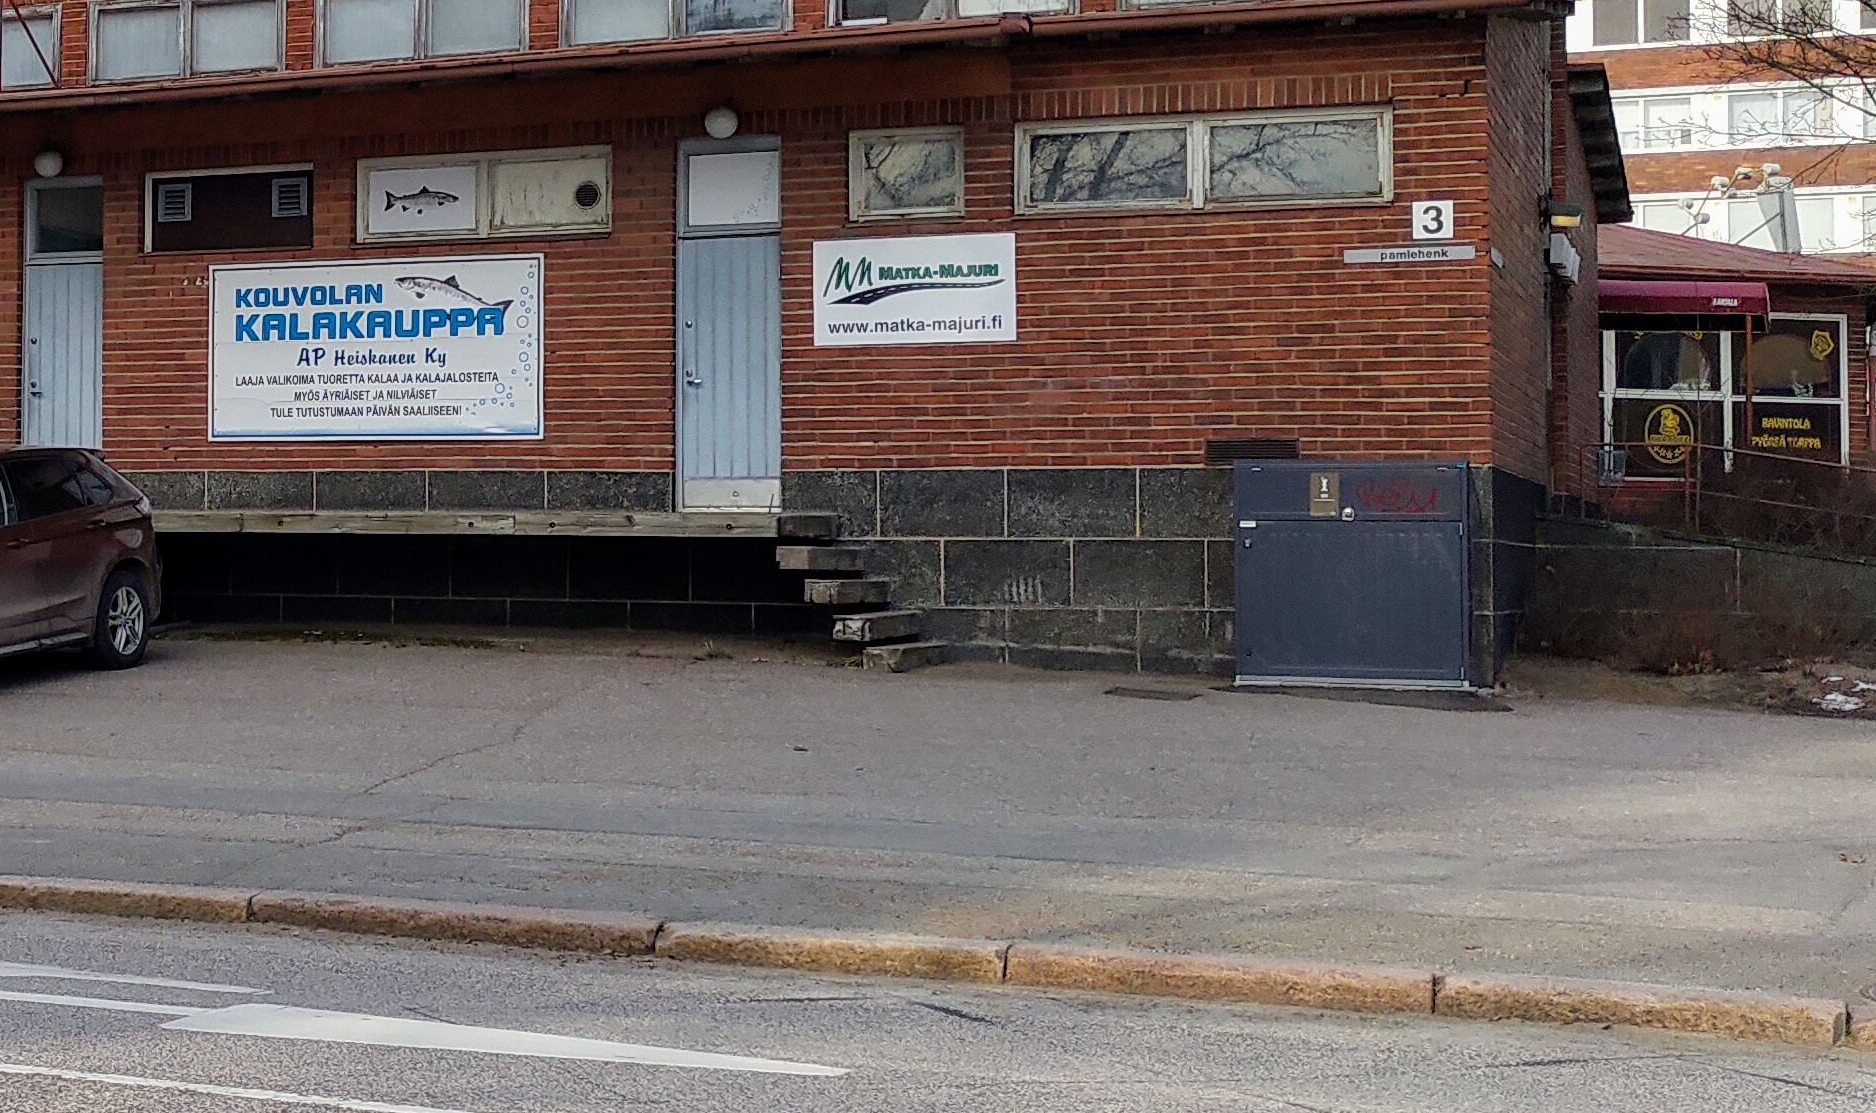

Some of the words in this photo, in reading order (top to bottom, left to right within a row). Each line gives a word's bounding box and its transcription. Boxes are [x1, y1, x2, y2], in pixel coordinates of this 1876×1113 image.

[1421, 205, 1444, 235] 3
[234, 283, 383, 308] KOUVOLAN
[234, 307, 505, 342] KALAKAUPPA
[828, 314, 1002, 334] www.matka-majuri.fi
[297, 347, 326, 367] AP
[333, 348, 417, 367] Heiskanen
[424, 347, 447, 368] Ky
[235, 375, 265, 387] LAAJA
[266, 374, 316, 386] VALIKOIMA
[317, 374, 365, 385] TUORETTA
[367, 372, 400, 384] KALAA
[401, 372, 414, 384] JA
[415, 371, 500, 383] KALAJALOSTEITA
[294, 390, 321, 402] MYÖS
[322, 388, 371, 401] ÄYRIÄISET
[373, 389, 385, 400] JA
[386, 387, 437, 400] NILVIÄISET
[270, 407, 294, 418] TULE
[296, 406, 364, 417] TUTUSTUMAAN
[366, 403, 401, 416] PÄIVÄN
